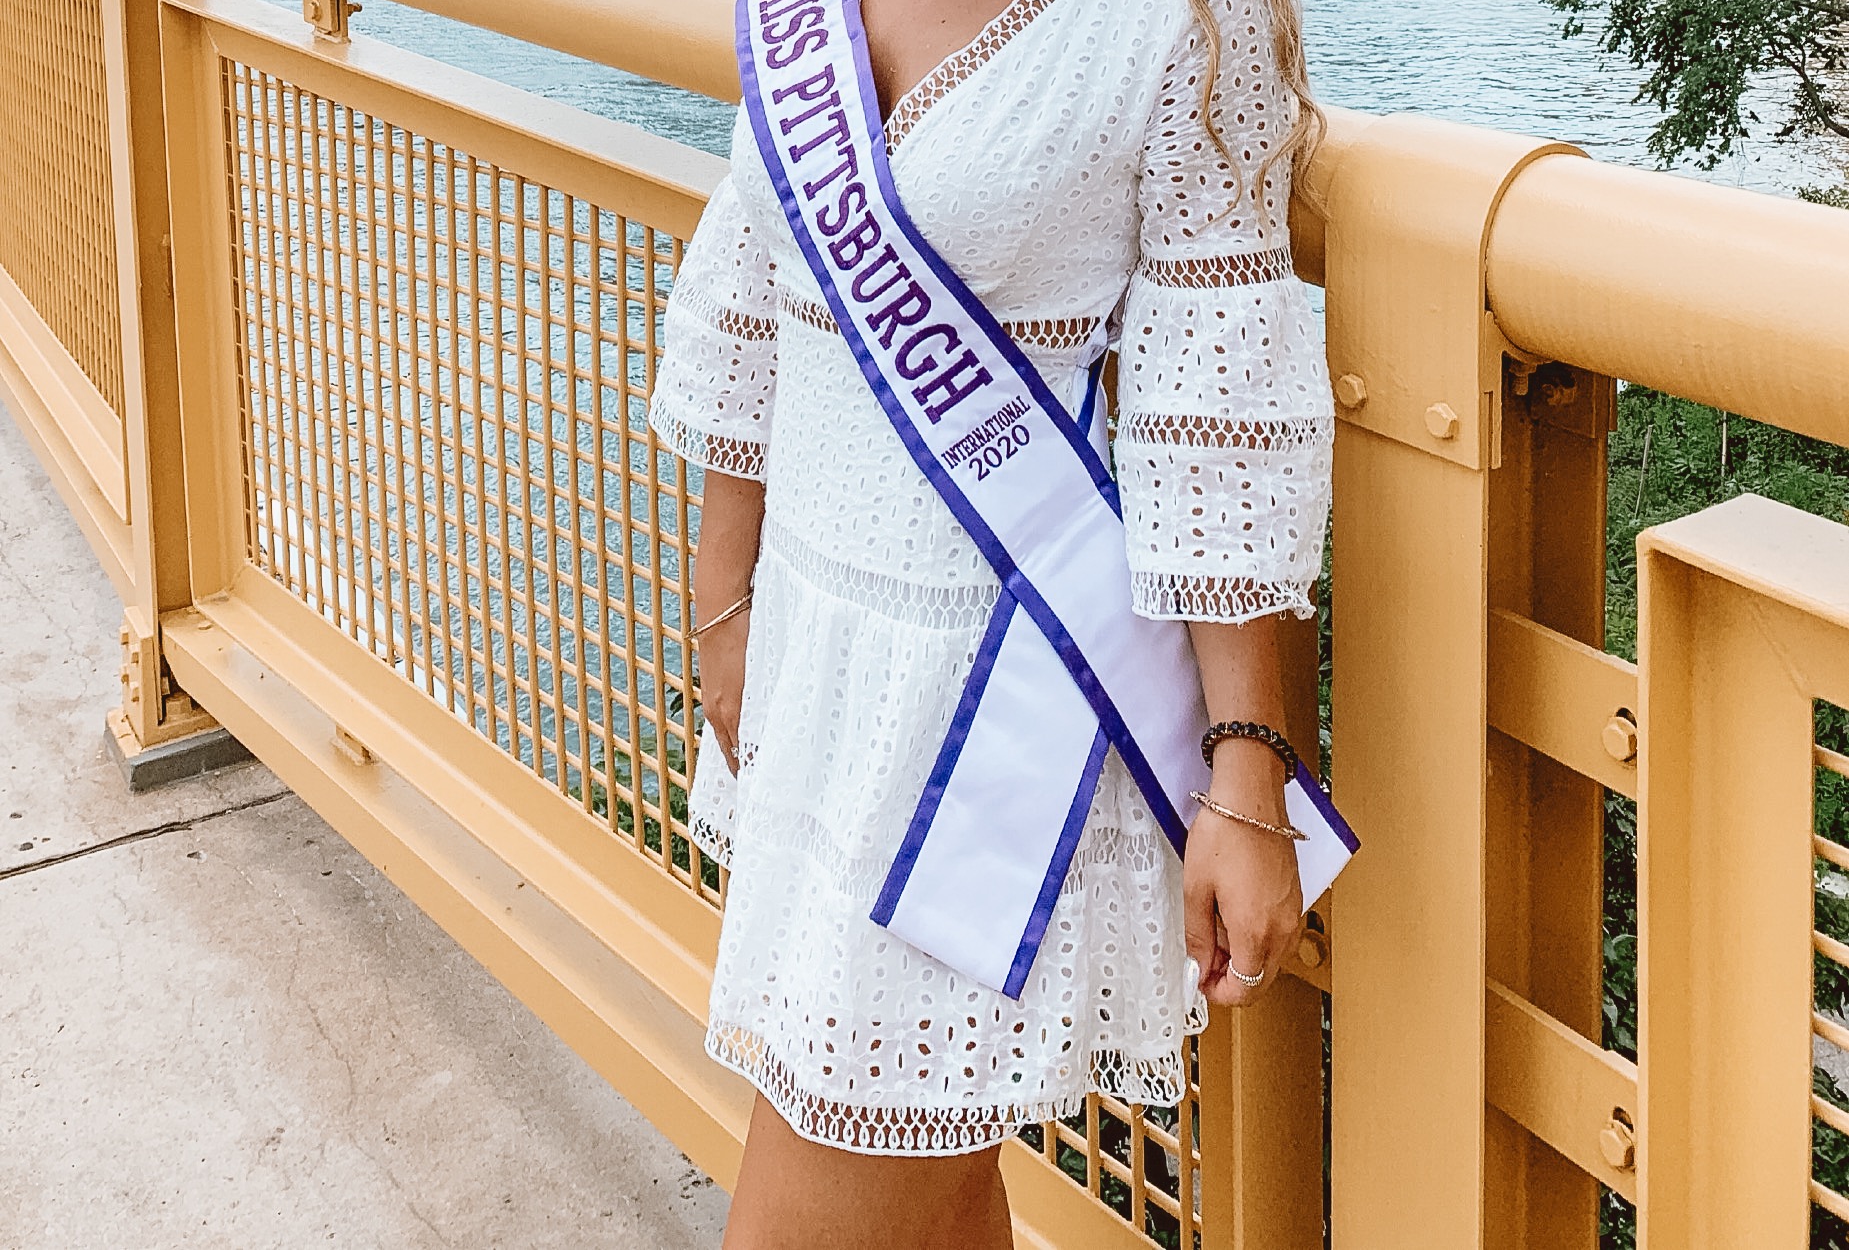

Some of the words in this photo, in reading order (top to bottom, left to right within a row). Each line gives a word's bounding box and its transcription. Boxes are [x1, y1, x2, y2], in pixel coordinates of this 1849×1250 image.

[773, 63, 993, 425] PITTSBURGH
[941, 395, 1031, 469] INTERNATIONAL
[969, 424, 1030, 481] 2020
